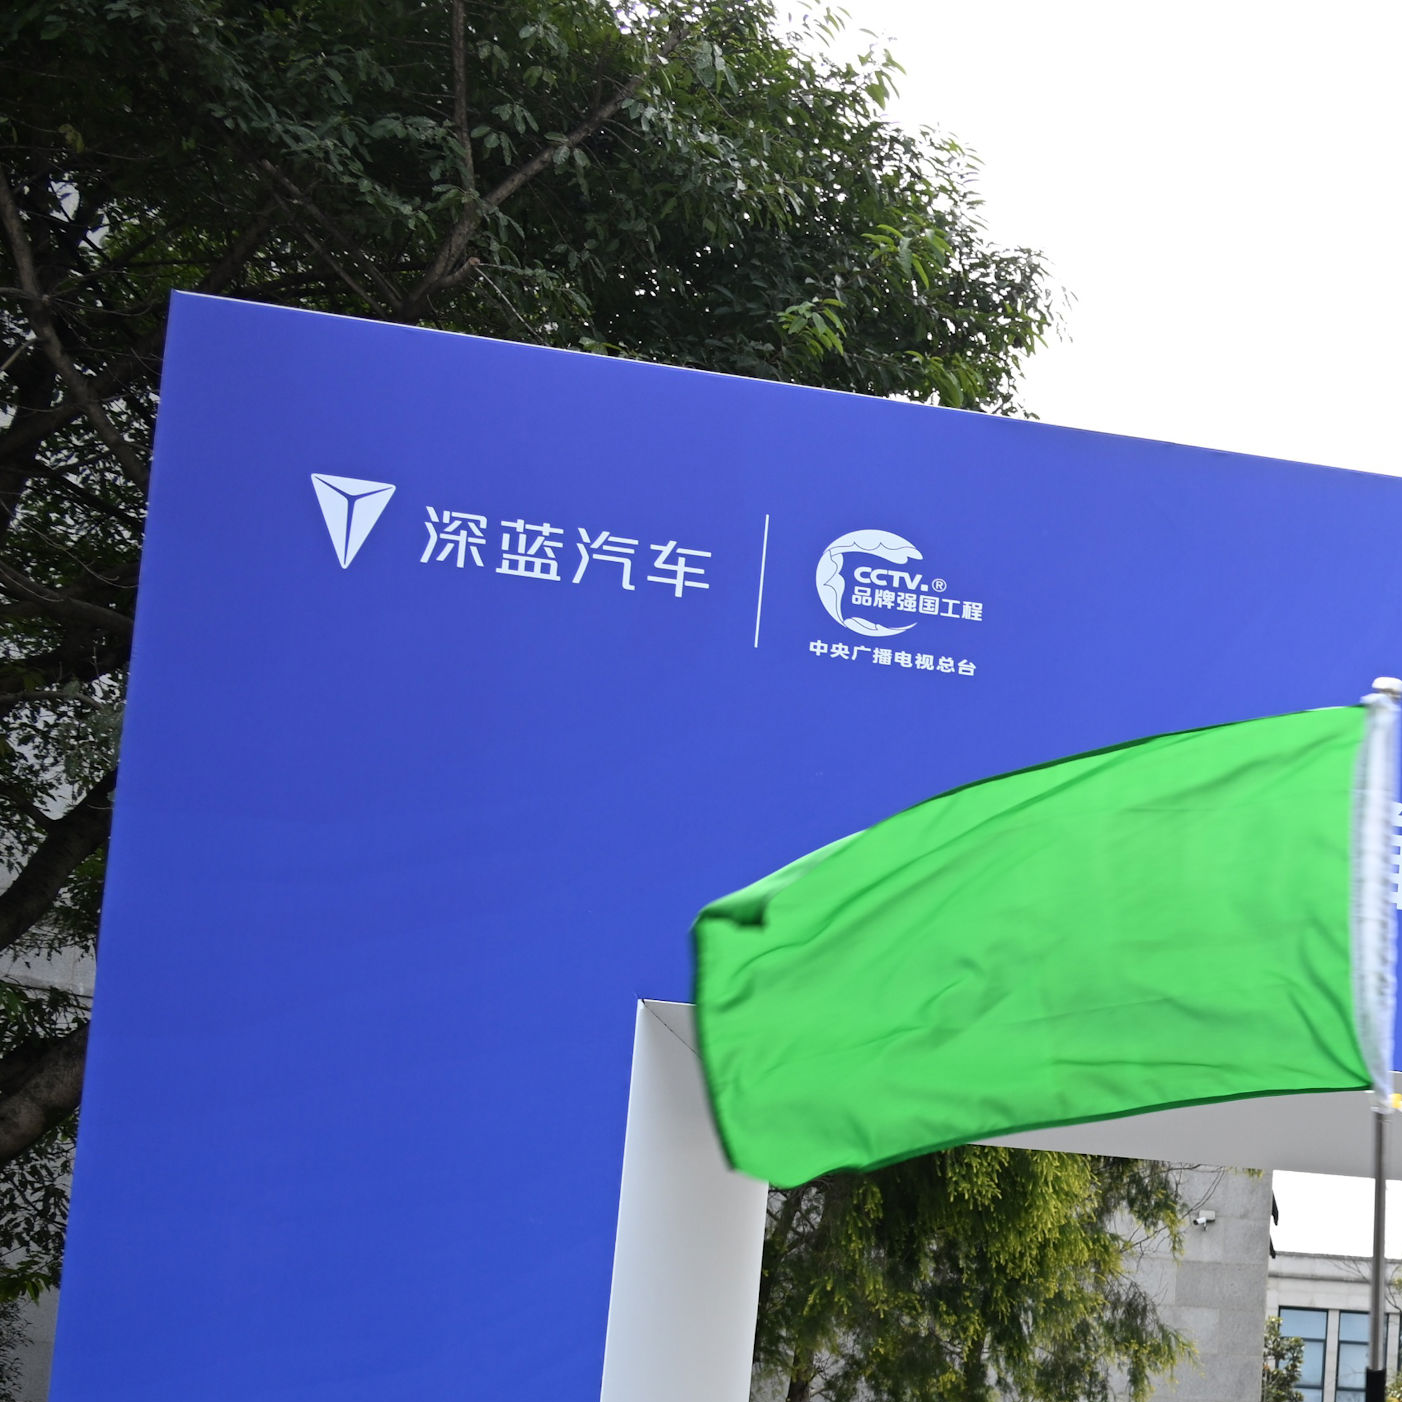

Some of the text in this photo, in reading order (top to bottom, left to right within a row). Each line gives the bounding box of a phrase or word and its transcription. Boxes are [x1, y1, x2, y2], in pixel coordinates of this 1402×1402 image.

[420, 505, 713, 599] 深蓝汽车
[851, 586, 983, 621] 品牌强国工程
[809, 639, 977, 676] 中央广播电视总台
